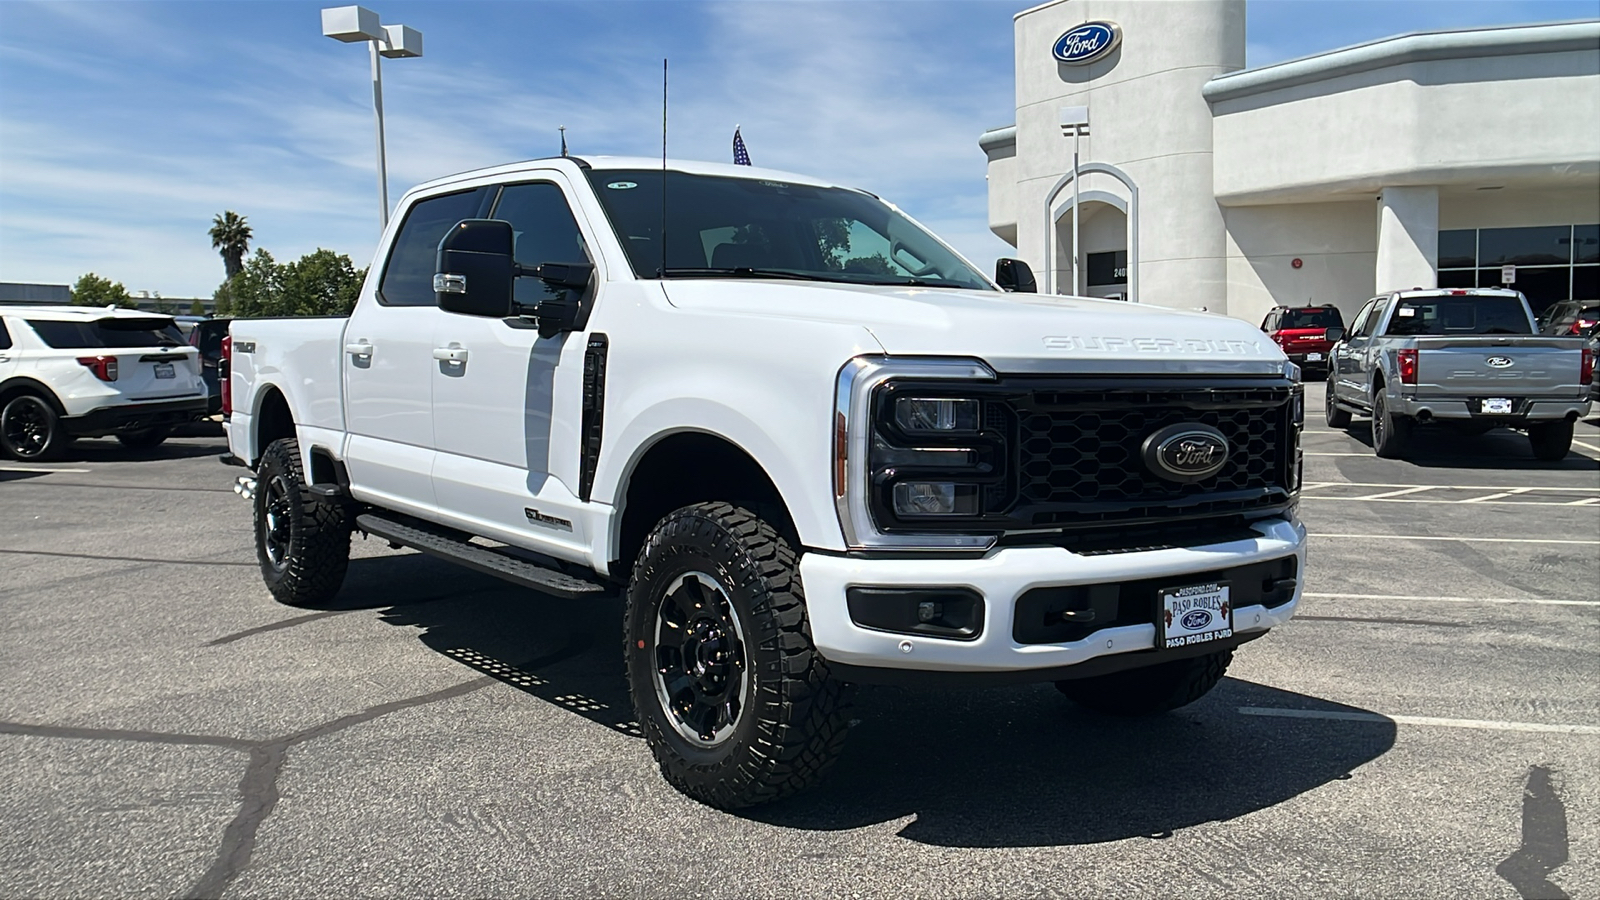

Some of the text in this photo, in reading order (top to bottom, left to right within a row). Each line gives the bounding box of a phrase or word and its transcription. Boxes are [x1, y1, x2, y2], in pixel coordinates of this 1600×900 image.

[1063, 29, 1100, 57] Ford
[1041, 335, 1262, 355] SUPER DUTY
[1447, 370, 1552, 380] F-150
[1176, 440, 1214, 465] Ford
[1172, 595, 1221, 617] PASO ROBLES
[1187, 613, 1207, 627] Ford
[1166, 629, 1232, 648] PASO ROBLES FORD
